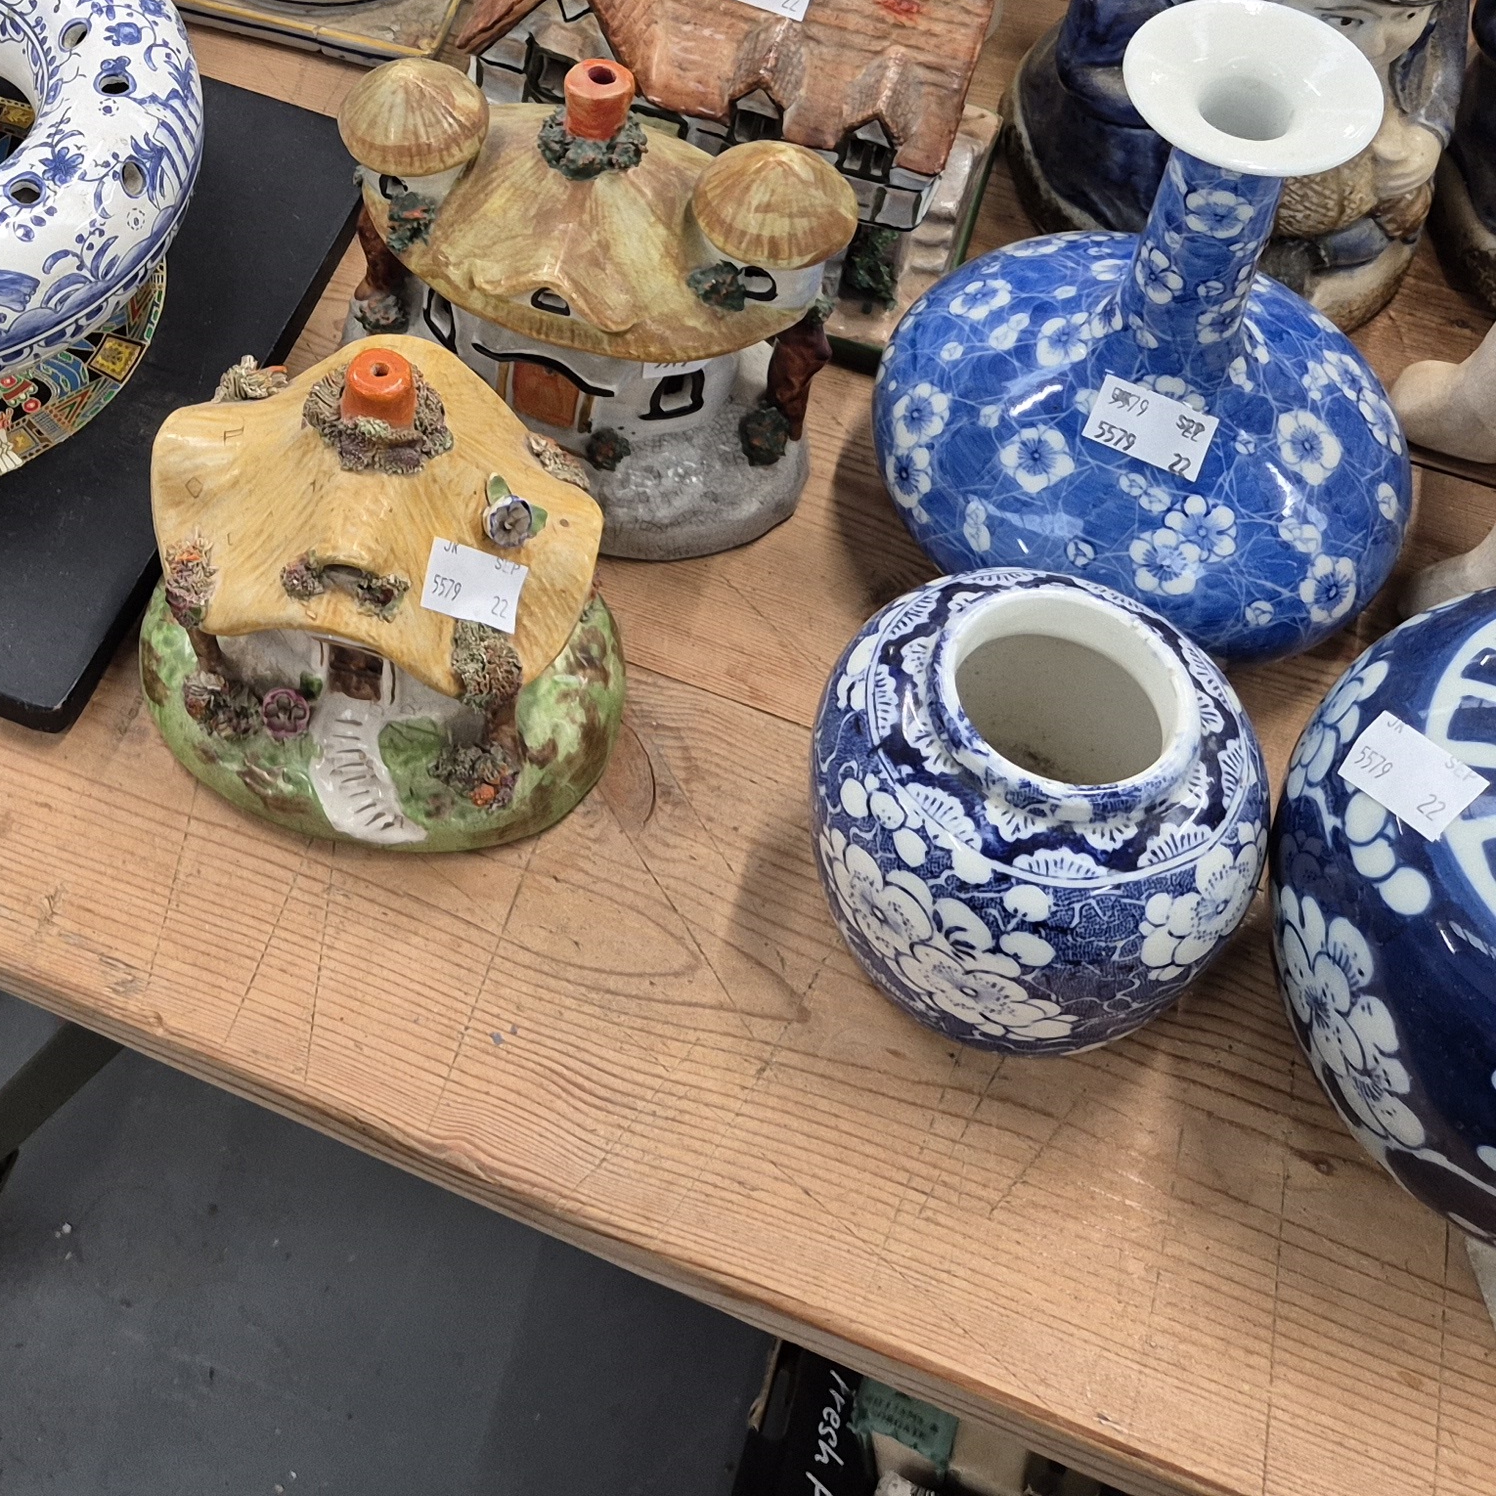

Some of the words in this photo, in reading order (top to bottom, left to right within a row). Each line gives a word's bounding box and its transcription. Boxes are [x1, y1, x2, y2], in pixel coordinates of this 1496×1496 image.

[1094, 420, 1137, 451] 5579
[1168, 453, 1192, 478] 22
[443, 541, 459, 555] JK
[494, 557, 521, 575] SEP
[431, 573, 462, 601] 5579
[491, 595, 508, 619] 22
[1354, 745, 1393, 779] 5579
[1416, 793, 1446, 822] 22
[1444, 756, 1478, 781] SEP
